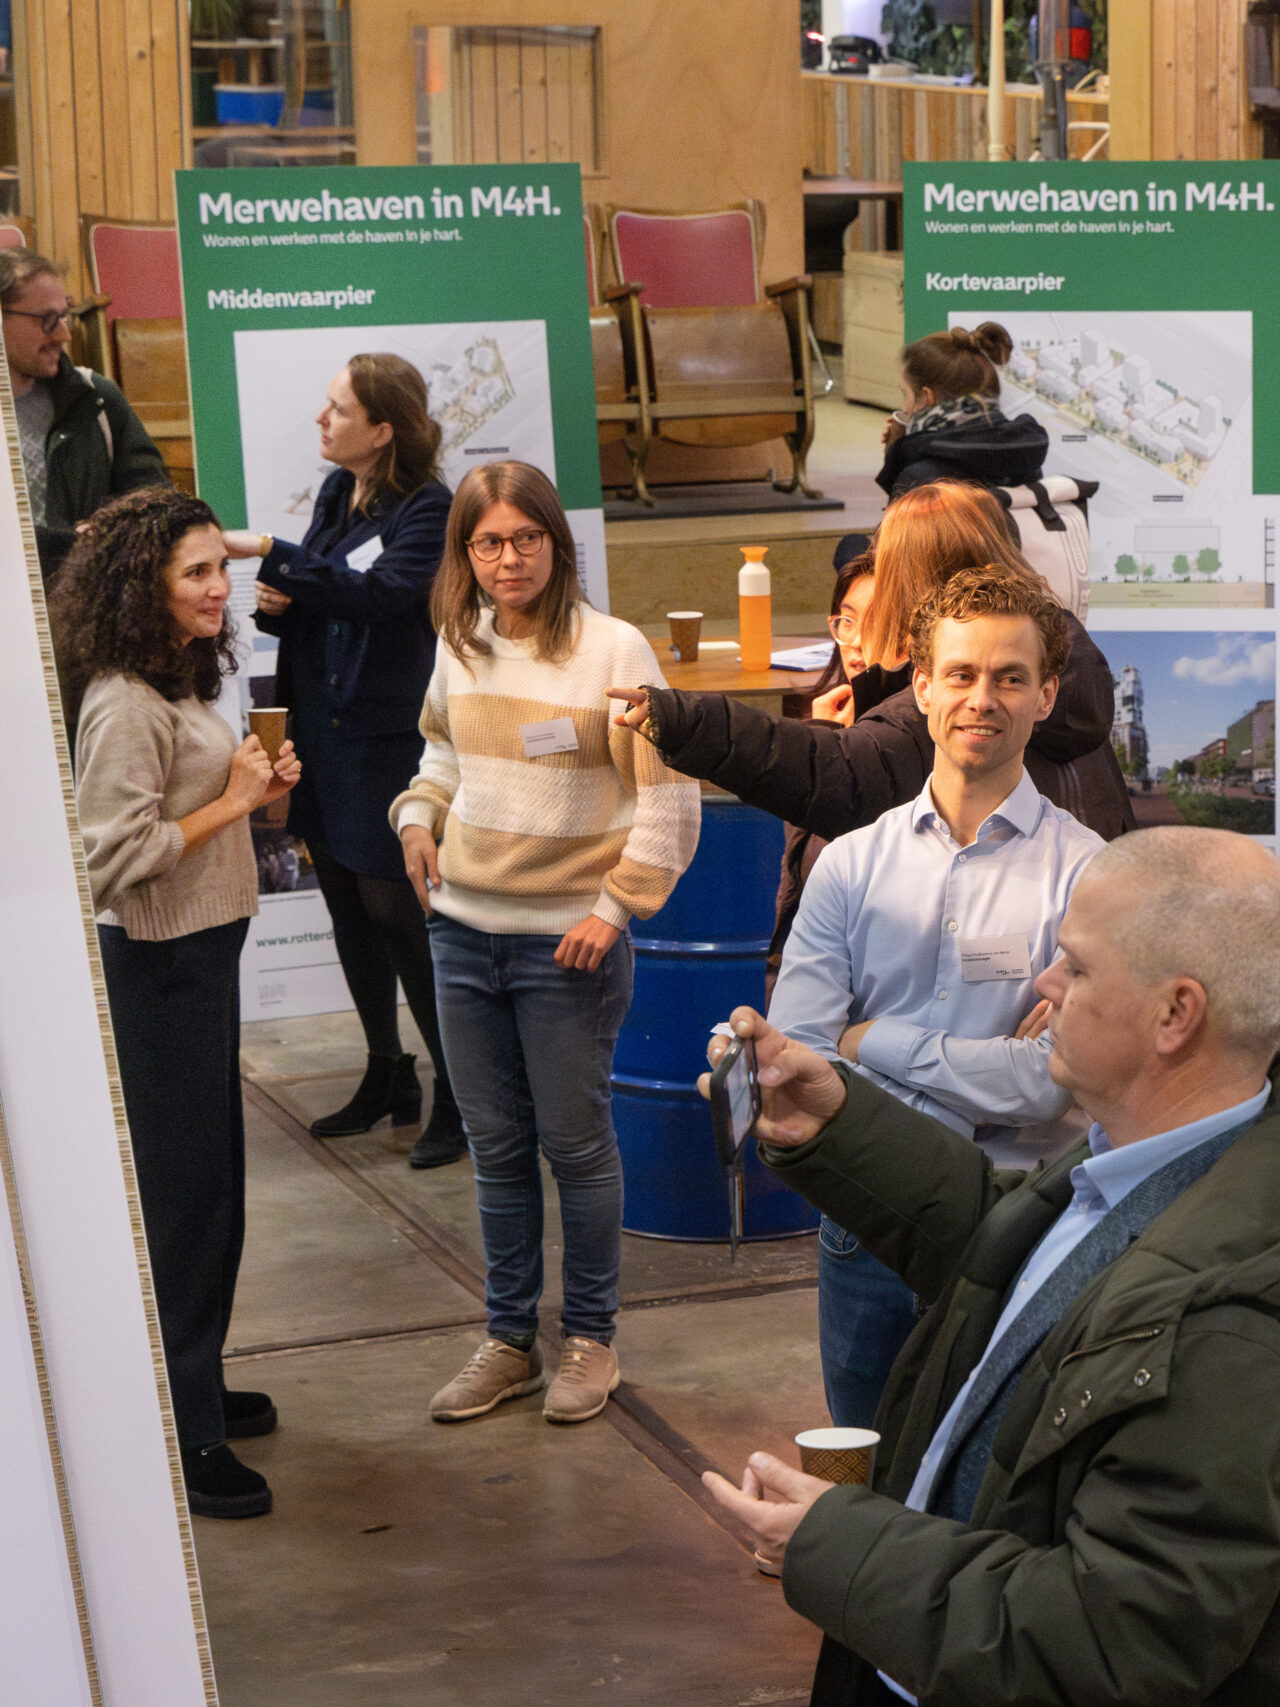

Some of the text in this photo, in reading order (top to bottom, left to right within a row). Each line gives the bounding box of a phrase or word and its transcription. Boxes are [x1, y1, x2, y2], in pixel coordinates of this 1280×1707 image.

[199, 185, 561, 225] Merwehaven in M4H.
[924, 181, 1275, 213] Merwehaven in M4H.
[202, 228, 463, 248] Wonen en werken met de haven in je hart.
[924, 220, 1175, 235] Wonen en werken met de haven in je hart.
[926, 272, 1065, 295] Kortevaarpier
[207, 285, 376, 310] Middenvaarpier
